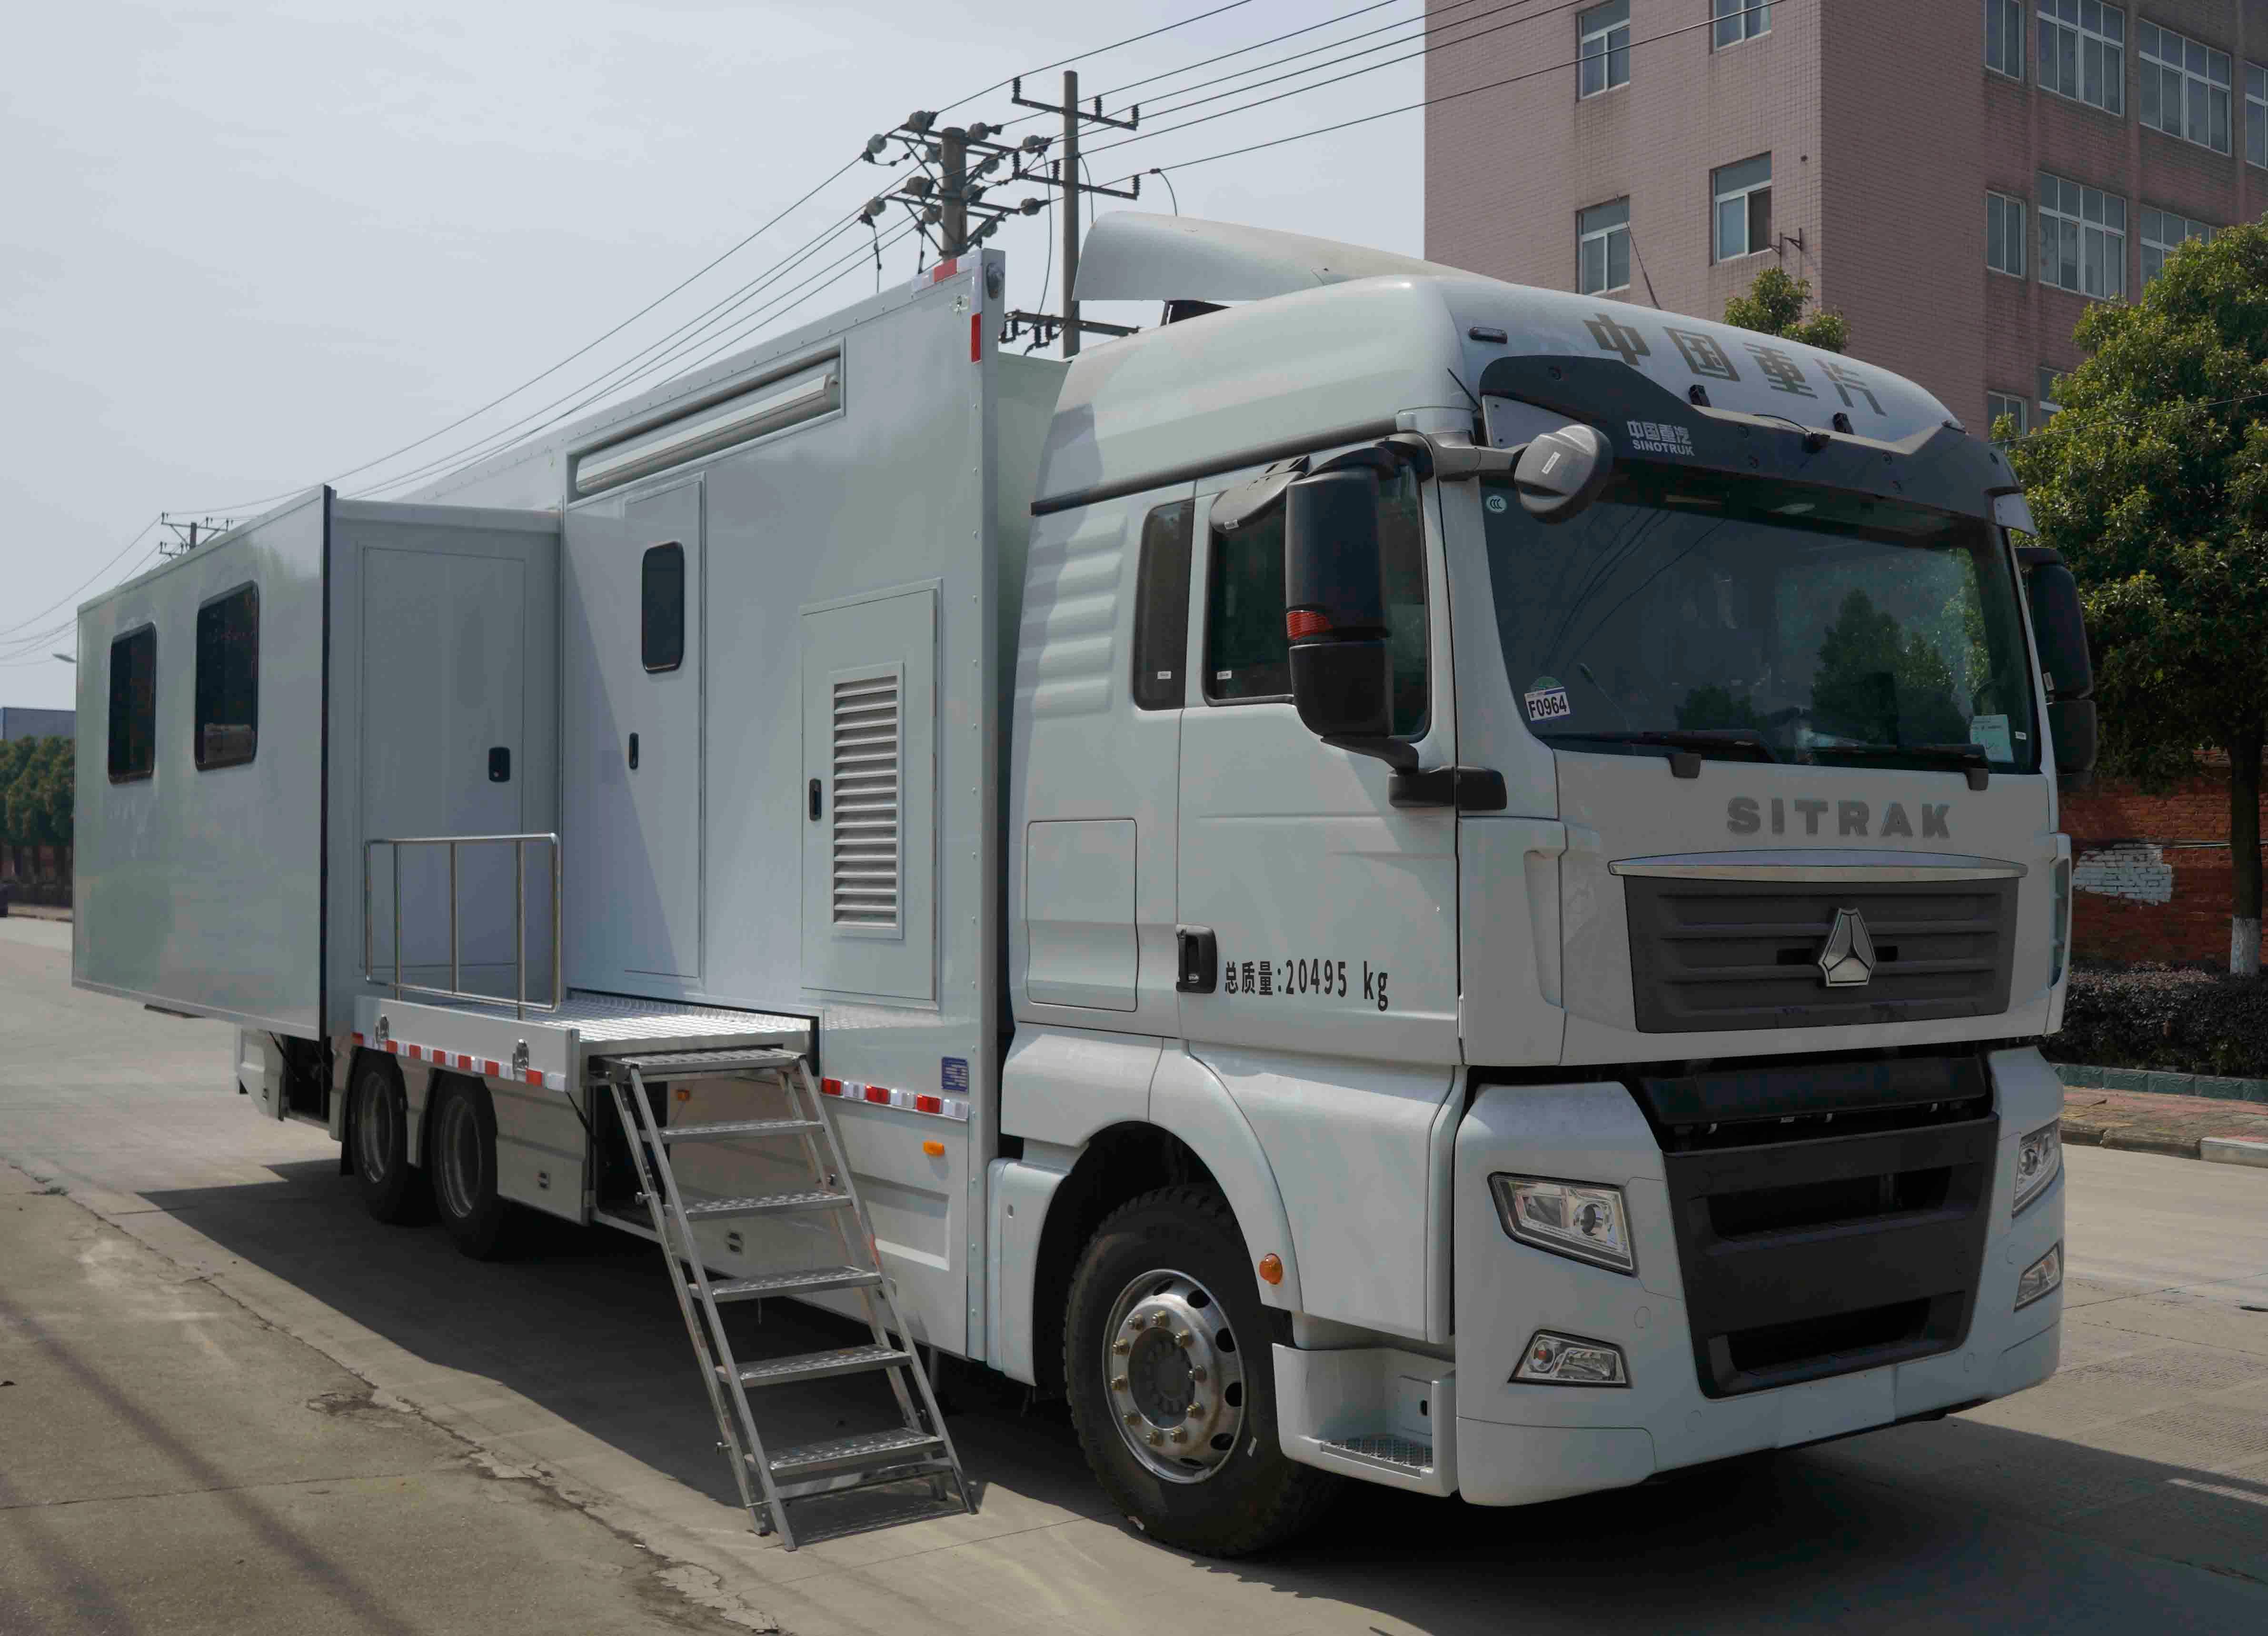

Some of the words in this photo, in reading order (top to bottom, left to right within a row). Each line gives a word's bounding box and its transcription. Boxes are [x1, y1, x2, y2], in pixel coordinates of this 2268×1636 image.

[1627, 420, 1691, 445] 中国重汽
[1632, 439, 1695, 456] SINOTRUK
[1528, 695, 1567, 718] F0964
[1727, 797, 1950, 838] SITRAK
[1224, 958, 1347, 998] 总质量:20495
[1363, 961, 1389, 1012] kg
